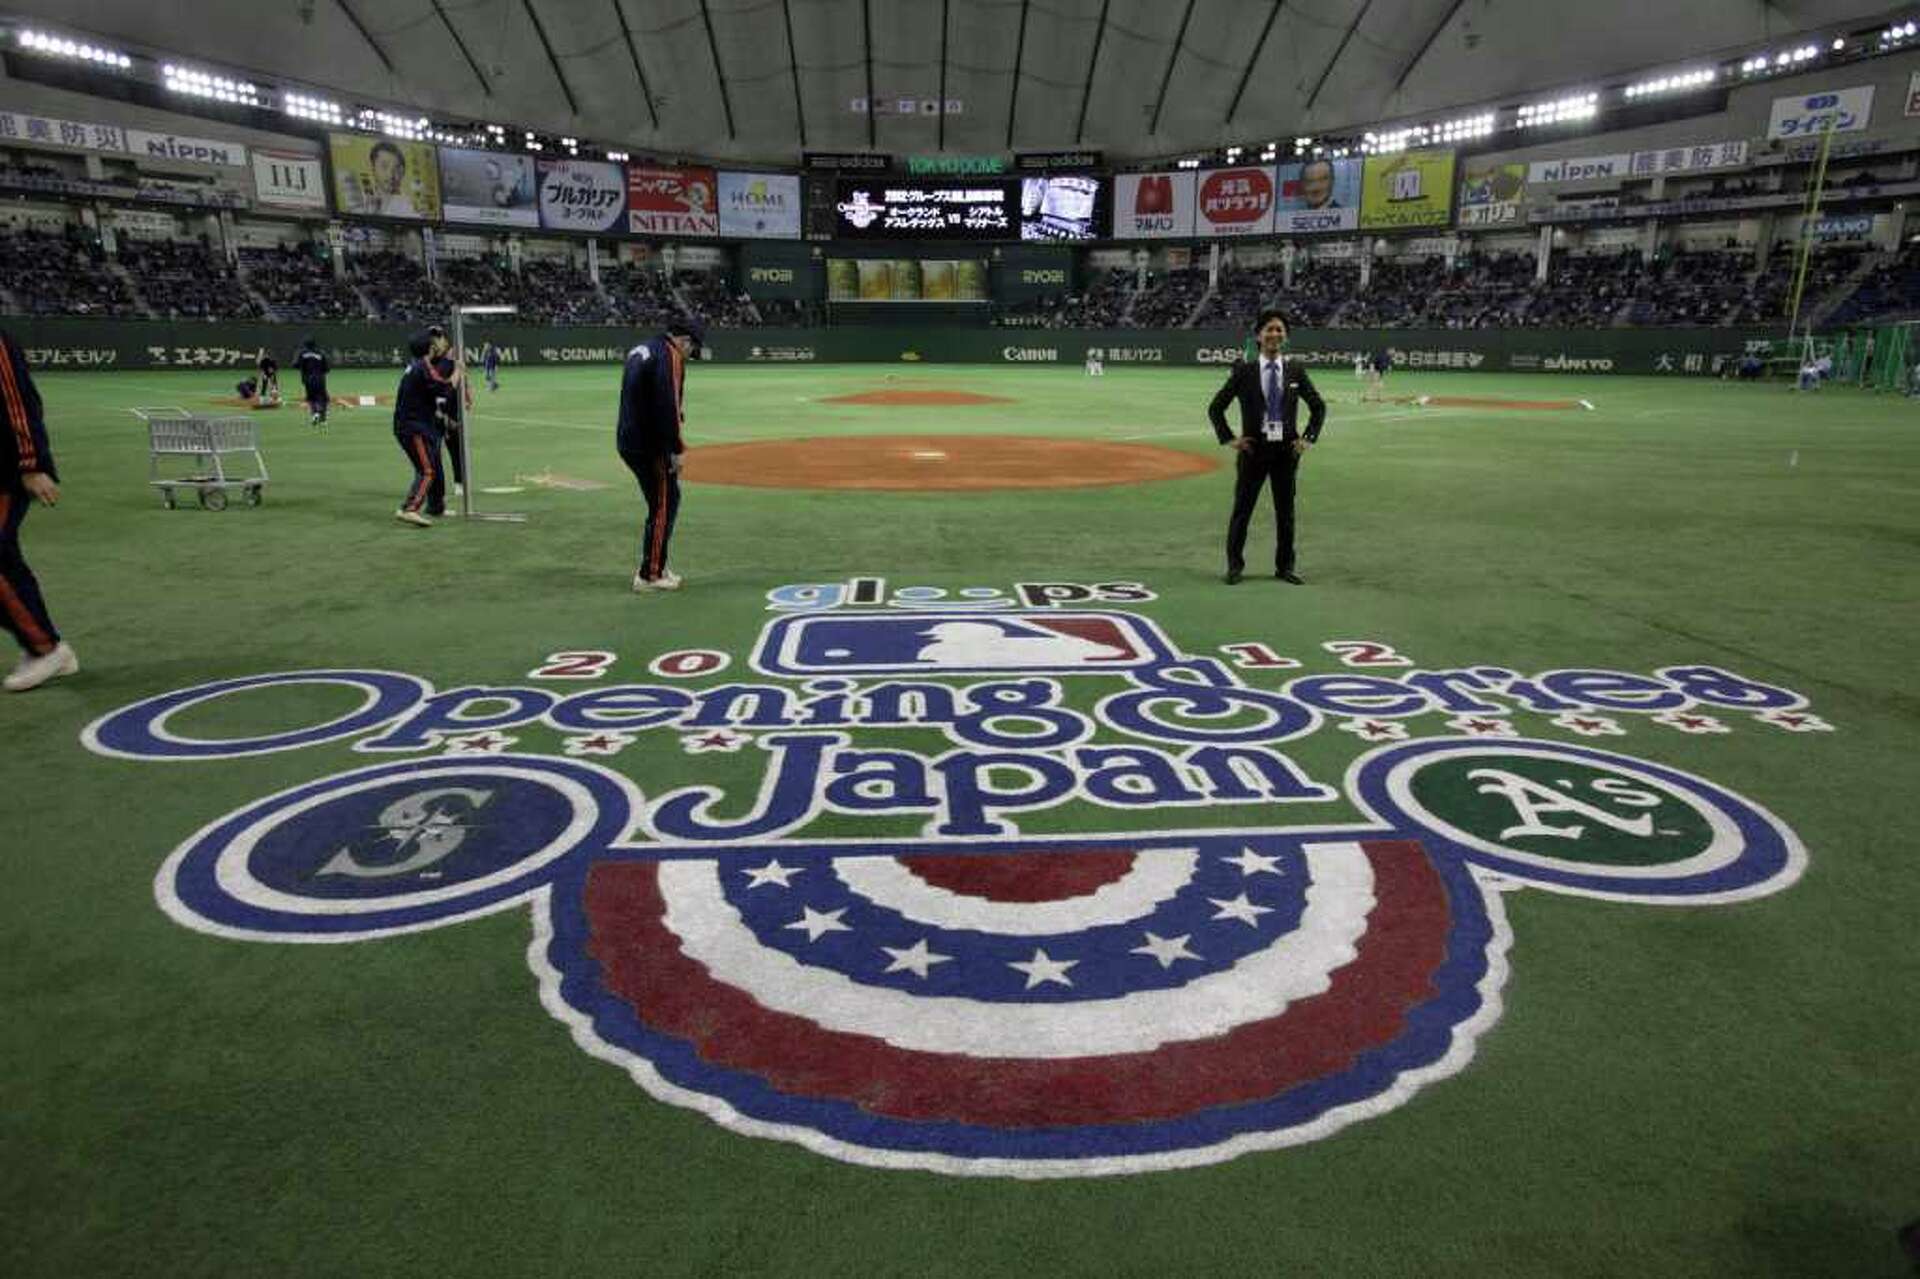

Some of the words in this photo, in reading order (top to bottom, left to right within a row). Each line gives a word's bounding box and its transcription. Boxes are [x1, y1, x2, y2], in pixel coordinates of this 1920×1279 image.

[632, 213, 716, 233] NITTAN
[1291, 215, 1341, 230] SECOM
[1003, 347, 1058, 361] Canon
[80, 667, 1096, 762] Opening
[1097, 656, 1812, 748] Series
[646, 731, 1339, 843] Japan
[1467, 768, 1667, 840] A's
